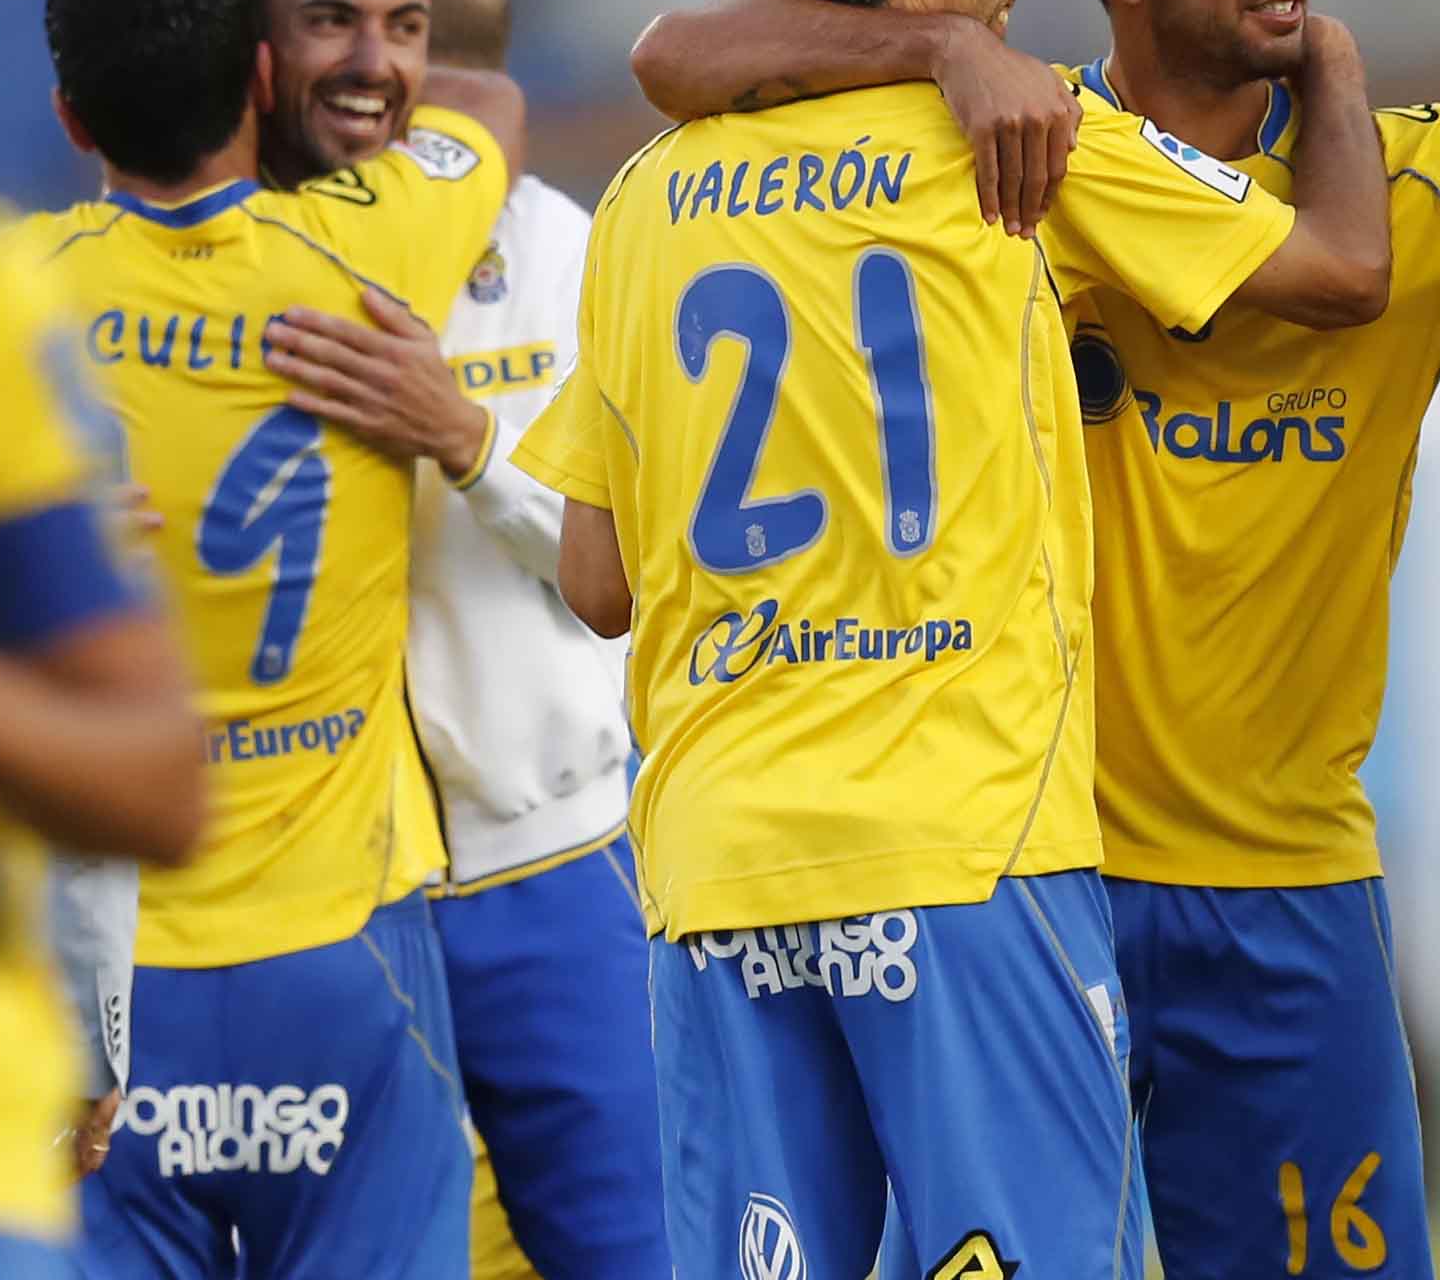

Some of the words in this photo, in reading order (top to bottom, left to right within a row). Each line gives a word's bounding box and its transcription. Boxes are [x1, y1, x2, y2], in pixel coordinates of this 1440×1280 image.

[667, 135, 912, 226] VALERÓN
[87, 310, 295, 372] CULI
[452, 351, 556, 390] DLP
[674, 247, 939, 575] 21
[1266, 387, 1347, 414] GRUPO
[196, 402, 332, 686] 9
[110, 1084, 349, 1136] OMINGO
[1278, 1151, 1388, 1276] 16
